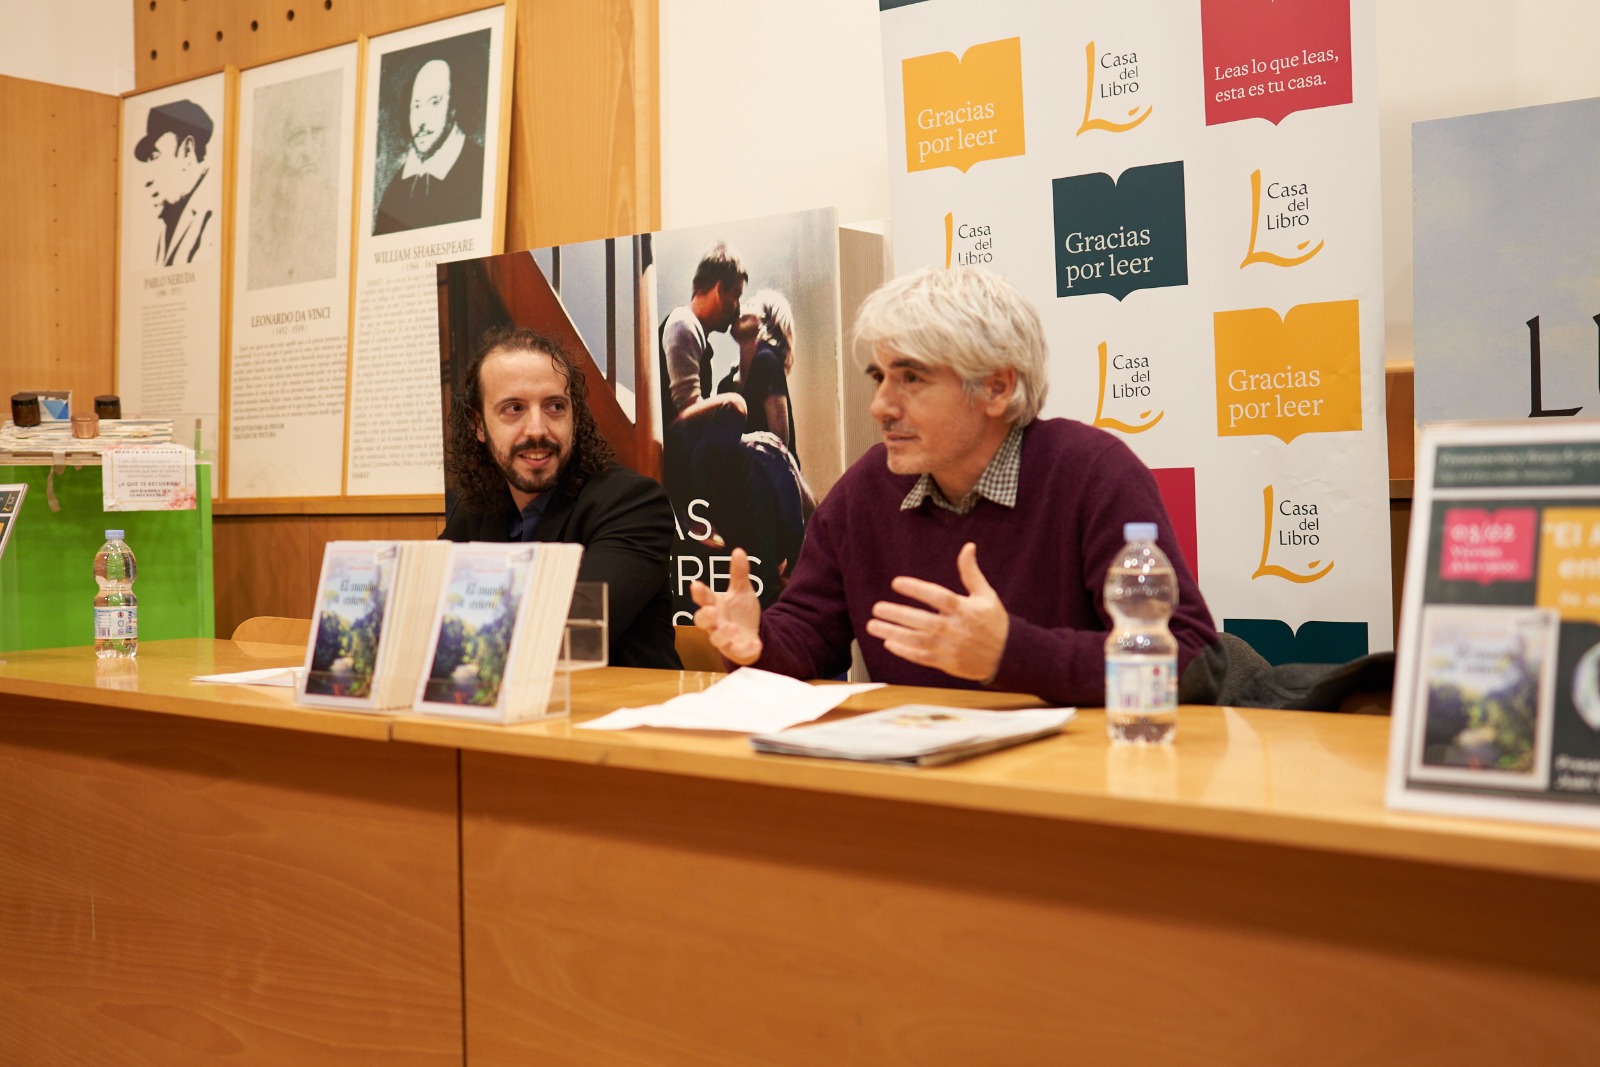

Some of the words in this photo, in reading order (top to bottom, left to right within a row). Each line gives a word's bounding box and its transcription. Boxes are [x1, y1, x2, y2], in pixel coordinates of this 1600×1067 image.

[1101, 50, 1138, 70] Casa
[1214, 62, 1248, 83] Leas
[1252, 58, 1267, 76] lo
[1270, 55, 1300, 78] que
[1302, 47, 1339, 70] leas,
[1119, 65, 1138, 80] del
[1101, 78, 1139, 100] Libro
[1215, 83, 1246, 103] esta
[1249, 82, 1264, 98] es
[1268, 78, 1284, 95] tu
[1287, 73, 1327, 92] casa.
[917, 98, 995, 131] Gracias
[918, 135, 953, 163] por
[957, 127, 998, 151] leer
[1267, 181, 1308, 200] Casa
[1287, 197, 1309, 213] del
[958, 222, 992, 240] Casa
[1266, 210, 1310, 232] Libro
[975, 236, 992, 251] del
[1065, 224, 1151, 255] Gracias
[374, 248, 411, 264] WILLIAM
[413, 238, 475, 259] SHAKESPEARE
[958, 249, 993, 267] Libro
[1066, 257, 1106, 289] por
[1110, 251, 1154, 277] leer
[251, 311, 294, 328] LEONARDO
[295, 310, 306, 322] DA
[308, 306, 331, 321] VINCI
[1113, 354, 1149, 370] Casa
[1526, 313, 1600, 418] L
[1131, 370, 1150, 383] del
[1228, 366, 1321, 392] Gracias
[1113, 383, 1151, 399] Libro
[1228, 402, 1271, 427] por
[1275, 396, 1324, 418] leer
[1279, 499, 1318, 516] Casa
[1299, 517, 1319, 531] del
[1279, 529, 1320, 546] Libro
[669, 555, 764, 598] RES
